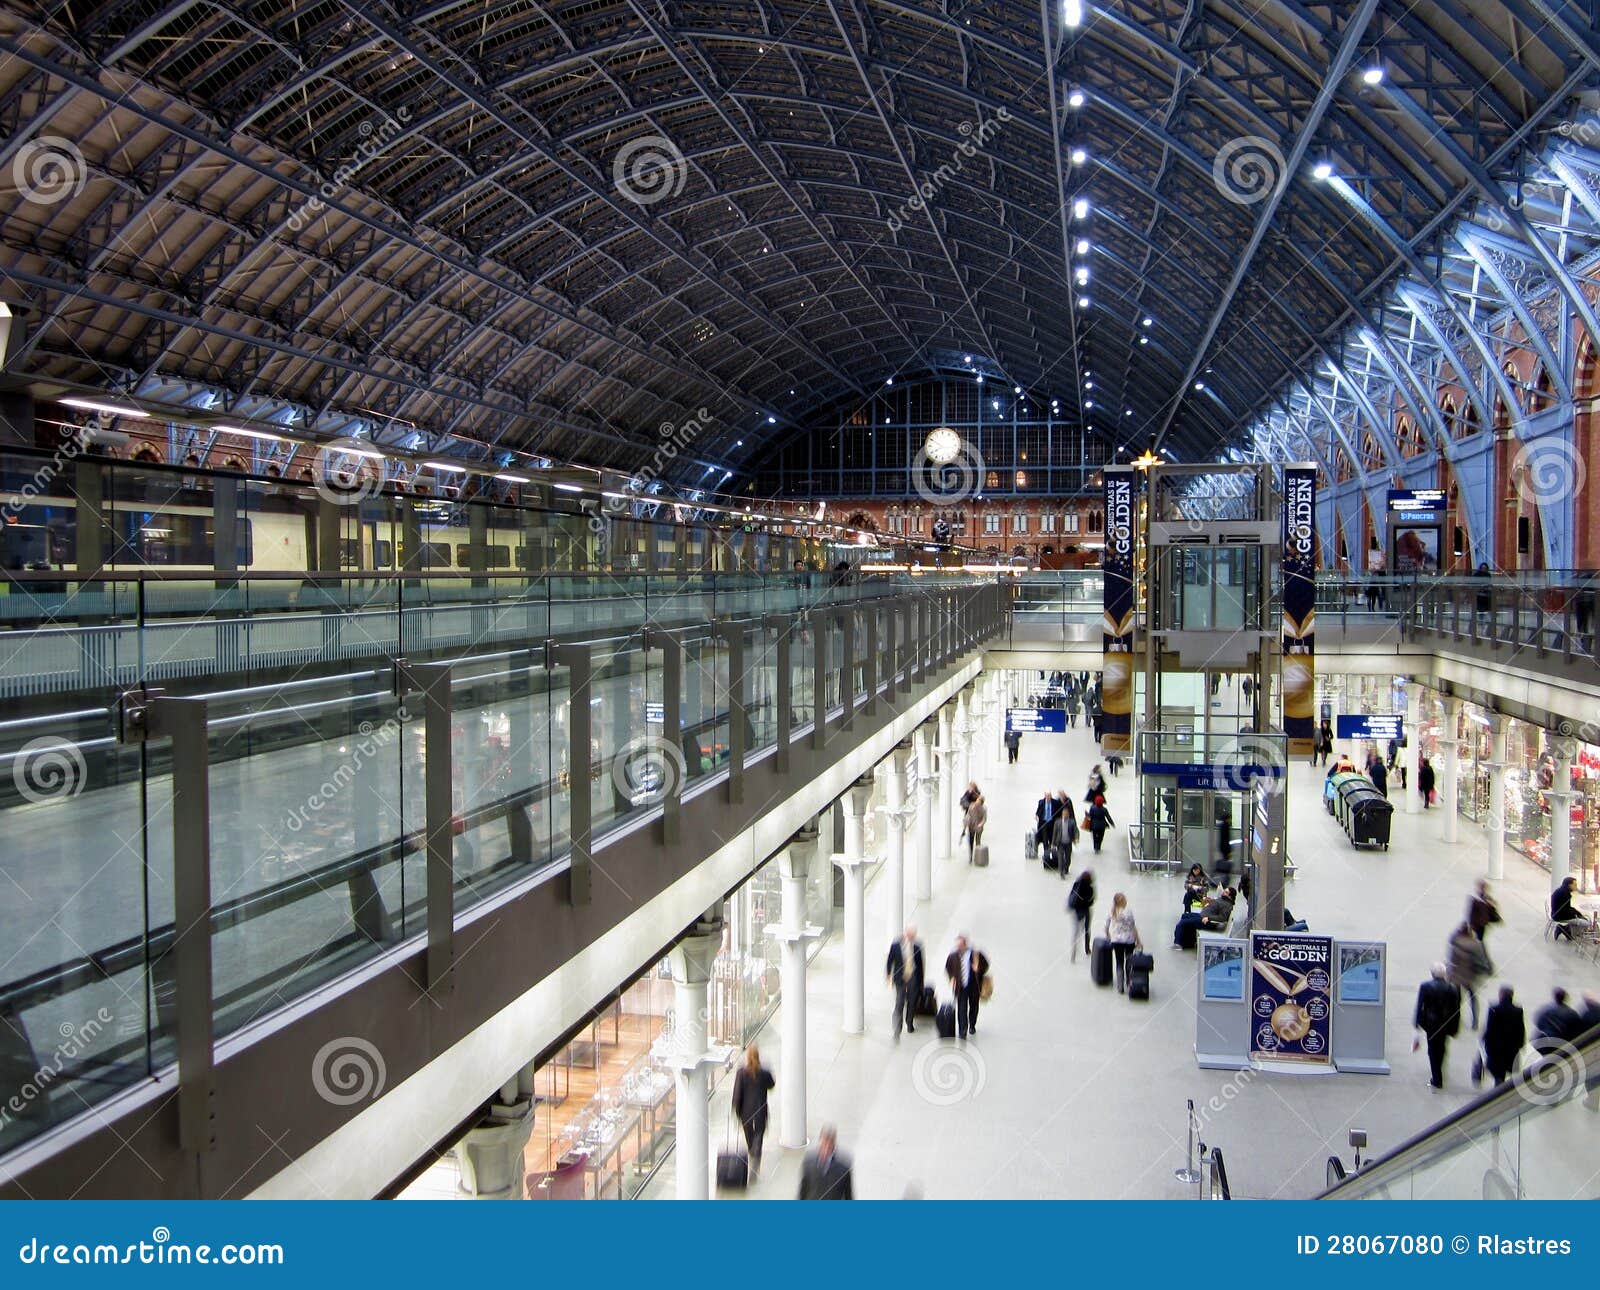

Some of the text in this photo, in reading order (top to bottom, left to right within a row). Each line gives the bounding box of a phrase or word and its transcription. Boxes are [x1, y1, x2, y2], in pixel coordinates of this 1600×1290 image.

[1107, 480, 1115, 536] CHRISTMAS IS
[1115, 480, 1130, 554] GOLDEN
[1288, 477, 1296, 536] CHRISTMAS IS
[1296, 479, 1312, 553] GOLDEN
[1268, 949, 1327, 963] GOLDEN
